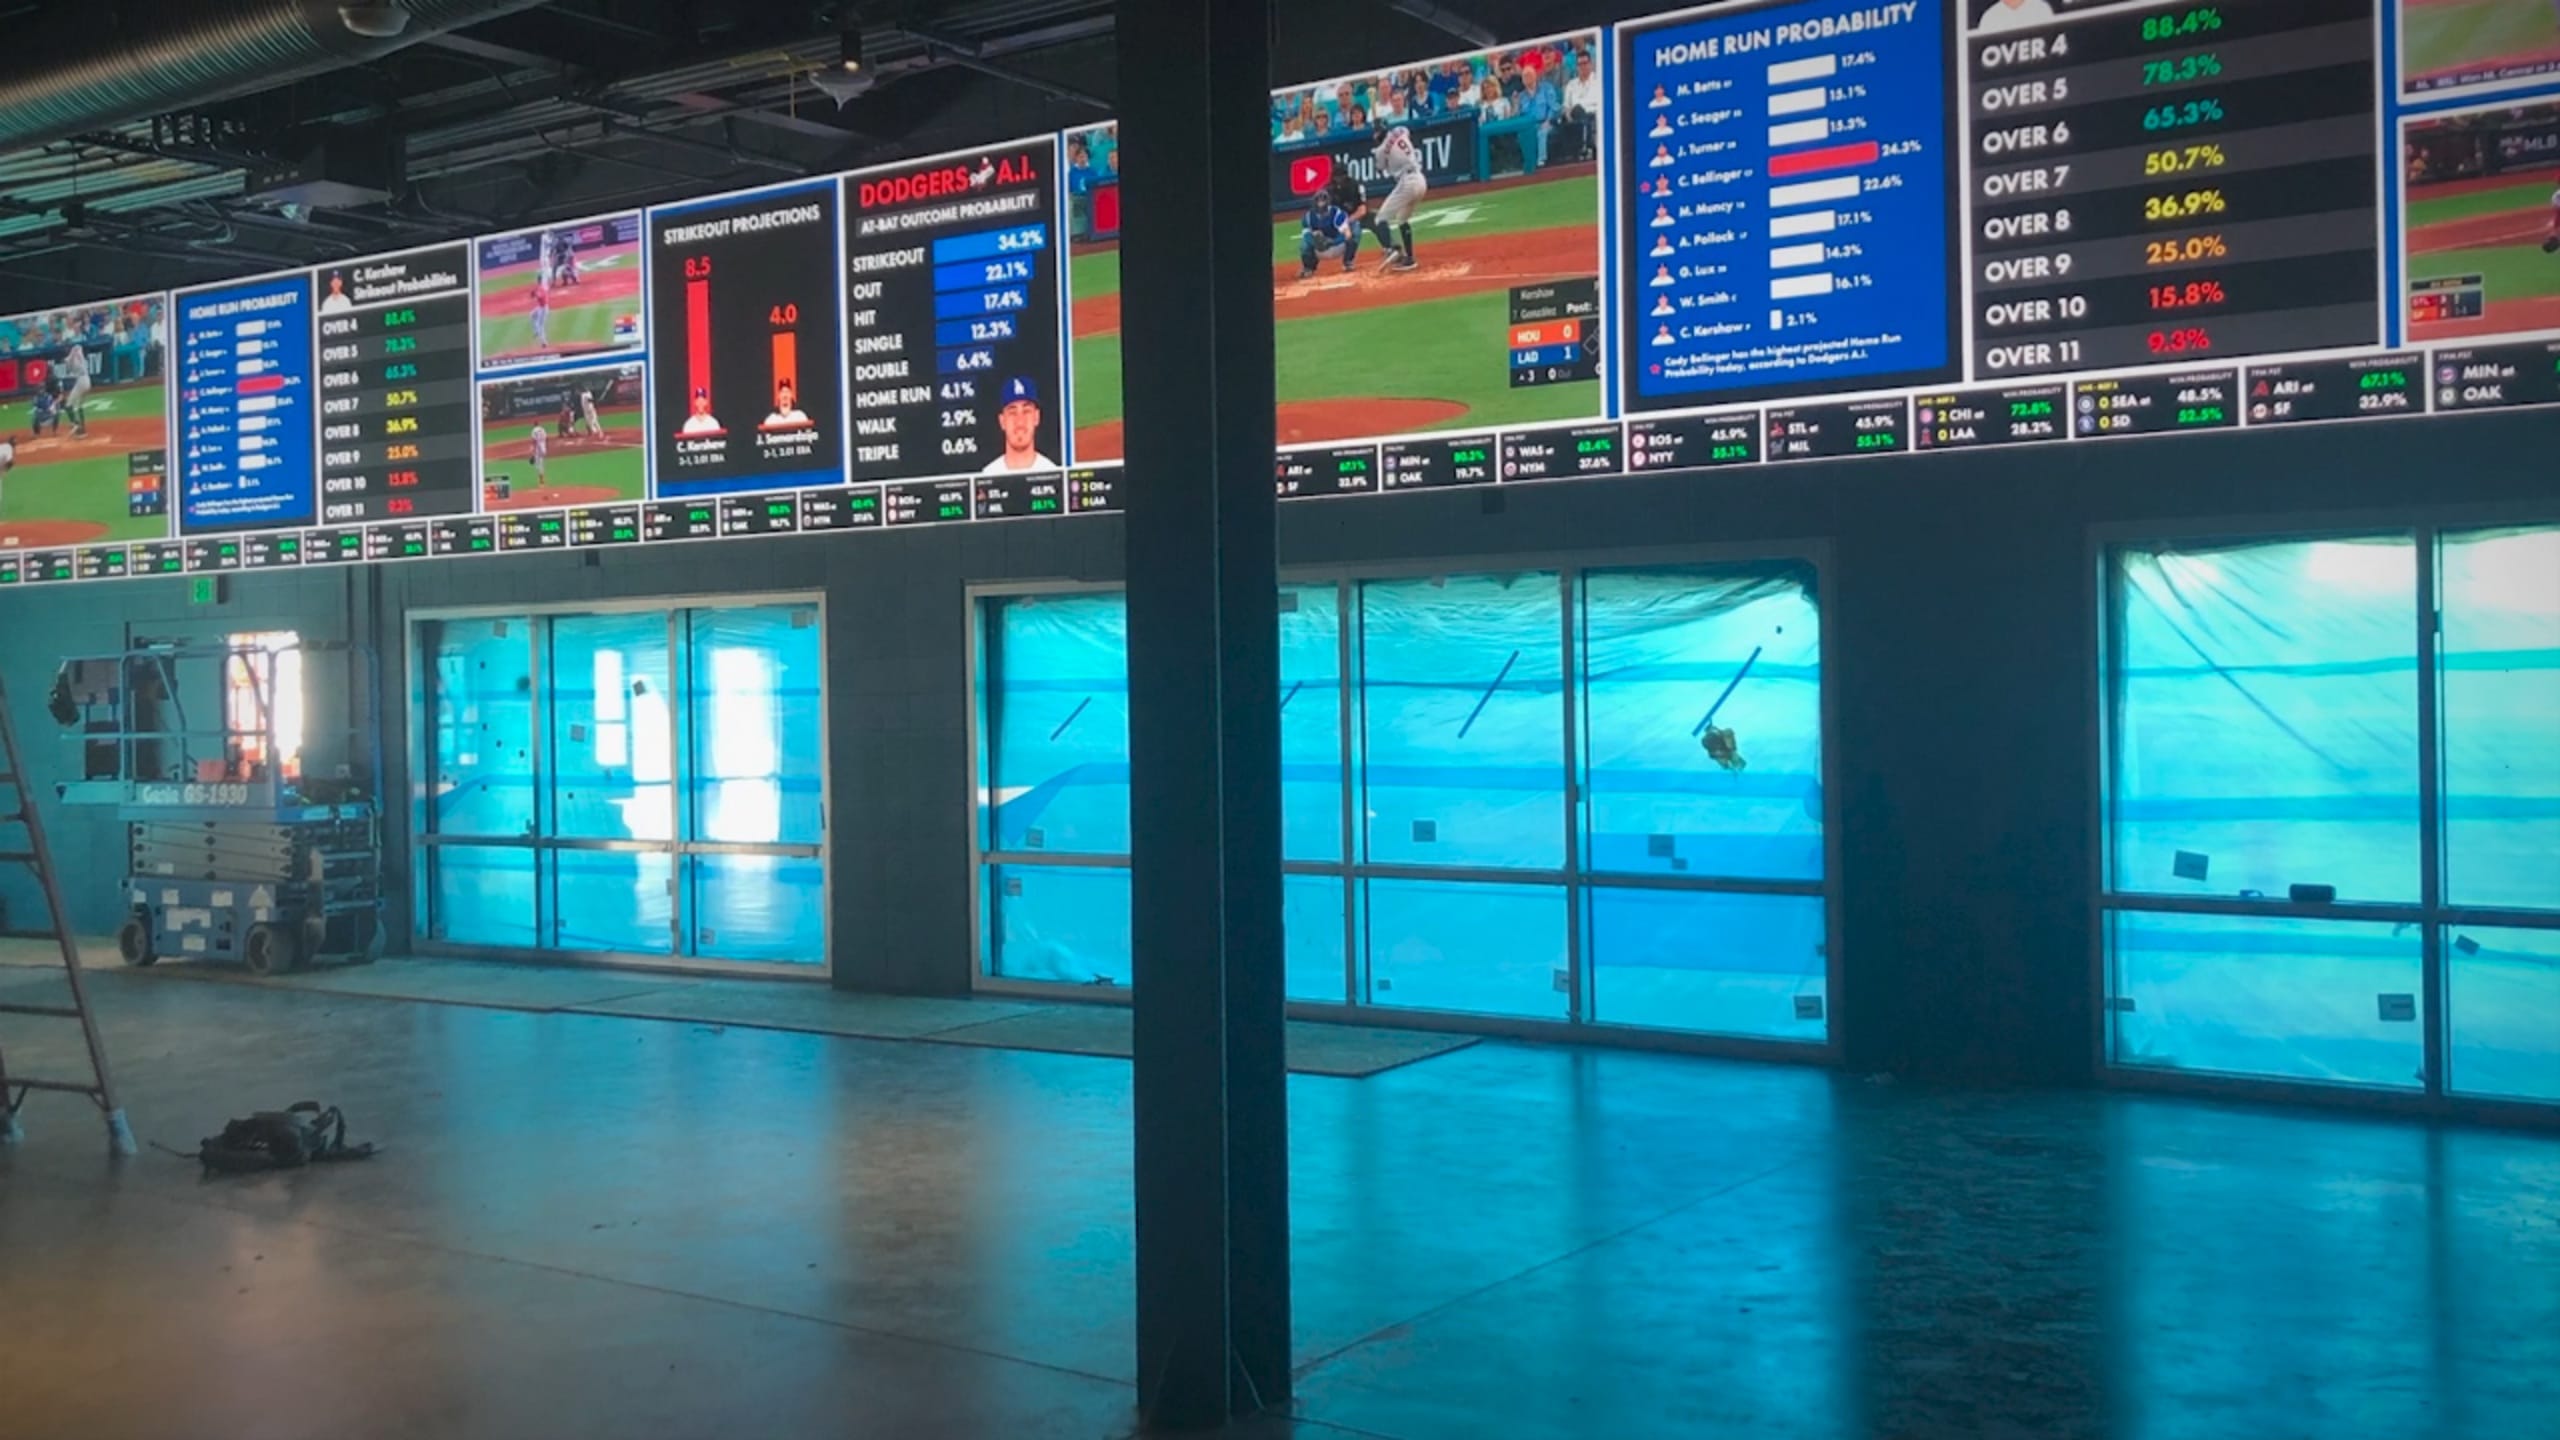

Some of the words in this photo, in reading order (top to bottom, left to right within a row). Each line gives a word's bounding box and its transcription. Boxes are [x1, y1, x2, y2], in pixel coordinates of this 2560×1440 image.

[1655, 38, 1719, 68] HOME
[1724, 29, 1771, 55] RUN
[1776, 1, 1917, 45] PROBABILITY
[1981, 38, 2046, 67] OVER
[2051, 34, 2068, 56] 4
[2142, 9, 2221, 40] 88.4%
[1841, 52, 1876, 68] 17.4%
[1982, 82, 2047, 110] OVER
[2053, 78, 2068, 100] 5
[2142, 54, 2222, 85] 78.3%
[1691, 109, 1731, 128] Seager
[1829, 85, 1866, 102] 15.1%
[1983, 125, 2047, 154] OVER
[2053, 121, 2070, 143] 6
[2143, 99, 2223, 130] 65.3%
[1423, 133, 1452, 171] TV
[1688, 141, 1725, 156] Turner
[1692, 169, 1742, 188] Bellinger
[1881, 140, 1922, 157] 24.3%
[1984, 169, 2048, 196] OVER
[2054, 166, 2070, 189] 7
[2144, 145, 2224, 175] 50.7%
[859, 165, 969, 208] DODGERS
[996, 155, 1036, 185] A.I.
[1696, 201, 1733, 217] Muncy
[1864, 174, 1902, 191] 22.6%
[664, 219, 731, 245] STRIKEOUT
[732, 204, 821, 233] PROJECTIONS
[861, 217, 898, 235] AT-BAT
[900, 205, 958, 228] OUTCOME
[960, 193, 1035, 218] PROBABILITY
[1984, 213, 2049, 239] OVER
[2055, 210, 2071, 231] 8
[2145, 190, 2225, 220] 36.9%
[1694, 231, 1734, 246] Pollock
[1838, 211, 1872, 227] 17.1%
[853, 247, 925, 273] STRIKEOUT
[998, 230, 1043, 250] 34.2%
[1985, 257, 2050, 283] OVER
[2055, 253, 2072, 275] 9
[2146, 235, 2226, 265] 25.0%
[685, 256, 711, 277] 8.5
[397, 272, 457, 292] Probabilities
[854, 282, 882, 299] OUT
[986, 261, 1027, 281] 22.1%
[1698, 293, 1729, 306] Smith
[1835, 274, 1872, 290] 16.1%
[769, 304, 797, 325] 4.0
[854, 310, 876, 327] HIT
[984, 291, 1022, 309] 17.4%
[1986, 300, 2050, 326] OVER
[2058, 296, 2086, 318] 10
[2150, 281, 2224, 310] 15.8%
[323, 320, 348, 335] OVER
[350, 318, 358, 331] 4
[855, 333, 902, 354] SINGLE
[971, 320, 1012, 340] 12.3%
[1563, 324, 1572, 339] 0
[1694, 322, 1743, 338] Kershaw
[1787, 312, 1817, 327] 2.1%
[323, 347, 348, 361] OVER
[351, 344, 358, 358] 5
[1517, 350, 1539, 364] LAD
[1563, 345, 1572, 360] 1
[1986, 343, 2051, 369] OVER
[2059, 340, 2080, 362] 11
[2147, 328, 2211, 353] 9.3%
[856, 361, 909, 380] DOUBLE
[957, 352, 992, 370] 6.4%
[2463, 364, 2499, 380] MIN
[324, 373, 349, 388] OVER
[351, 371, 359, 384] 6
[2273, 381, 2299, 395] ARI
[2360, 371, 2405, 388] 67.1%
[856, 390, 898, 408] HOME
[900, 386, 931, 403] RUN
[940, 381, 974, 399] 4.1%
[2099, 396, 2109, 408] 0
[2112, 394, 2137, 407] SEA
[2178, 387, 2223, 402] 48.5%
[2274, 402, 2291, 415] SF
[2359, 393, 2407, 410] 32.9%
[2463, 385, 2502, 401] OAK
[324, 399, 350, 414] OVER
[352, 397, 359, 410] 7
[1937, 410, 1948, 423] 2
[1950, 407, 1973, 422] CHI
[2010, 401, 2052, 417] 72.8%
[856, 417, 896, 435] WALK
[942, 409, 976, 427] 2.9%
[1788, 422, 1808, 435] STL
[1855, 415, 1894, 430] 45.9%
[2099, 416, 2110, 429] 0
[2112, 414, 2131, 428] SD
[2178, 407, 2223, 423] 52.5%
[325, 426, 350, 439] OVER
[353, 423, 360, 437] 8
[1648, 434, 1672, 447] BOS
[1856, 433, 1894, 448] 55.1%
[1938, 428, 1948, 442] 0
[1950, 426, 1976, 440] LAA
[2010, 421, 2052, 436] 28.2%
[325, 452, 351, 466] OVER
[353, 450, 360, 463] 9
[857, 444, 899, 462] TRIPLE
[942, 437, 977, 455] 0.6%
[1519, 446, 1544, 457] WAS
[326, 478, 352, 492] OVER
[354, 476, 366, 489] 10
[326, 505, 352, 518] OVER
[355, 502, 364, 516] 11
[184, 784, 248, 803] GS-1930
